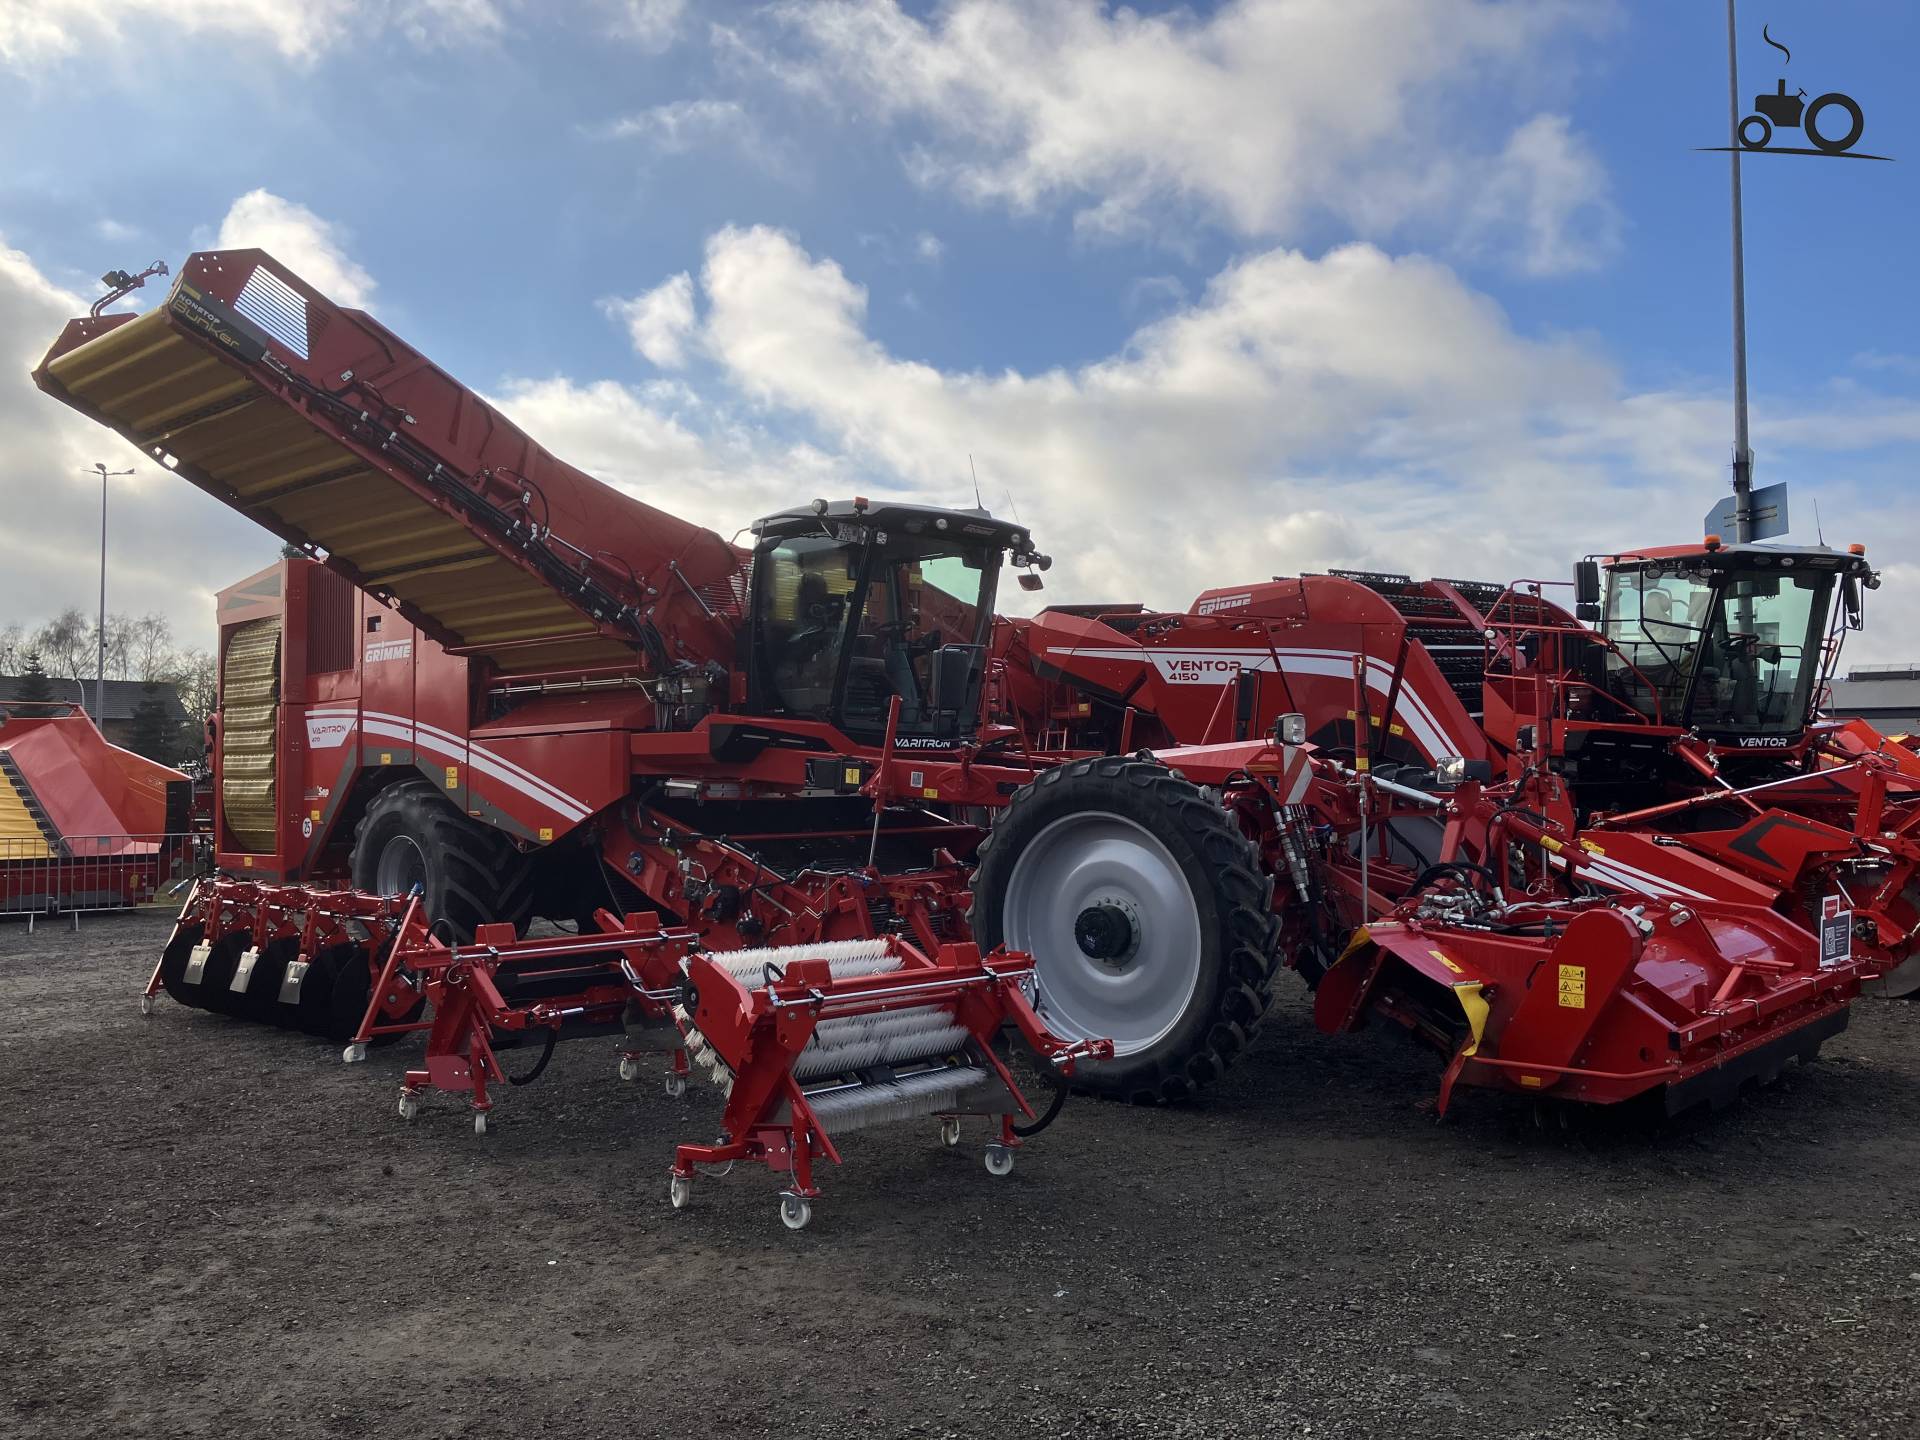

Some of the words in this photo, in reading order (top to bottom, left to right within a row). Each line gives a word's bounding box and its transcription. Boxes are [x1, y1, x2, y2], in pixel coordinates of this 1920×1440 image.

[178, 293, 220, 324] NONSTOP
[365, 644, 412, 663] GRIMME
[1168, 672, 1200, 681] 4150
[311, 725, 346, 735] VARITRON
[895, 738, 951, 748] VARITRON
[1739, 737, 1788, 747] VENTOR
